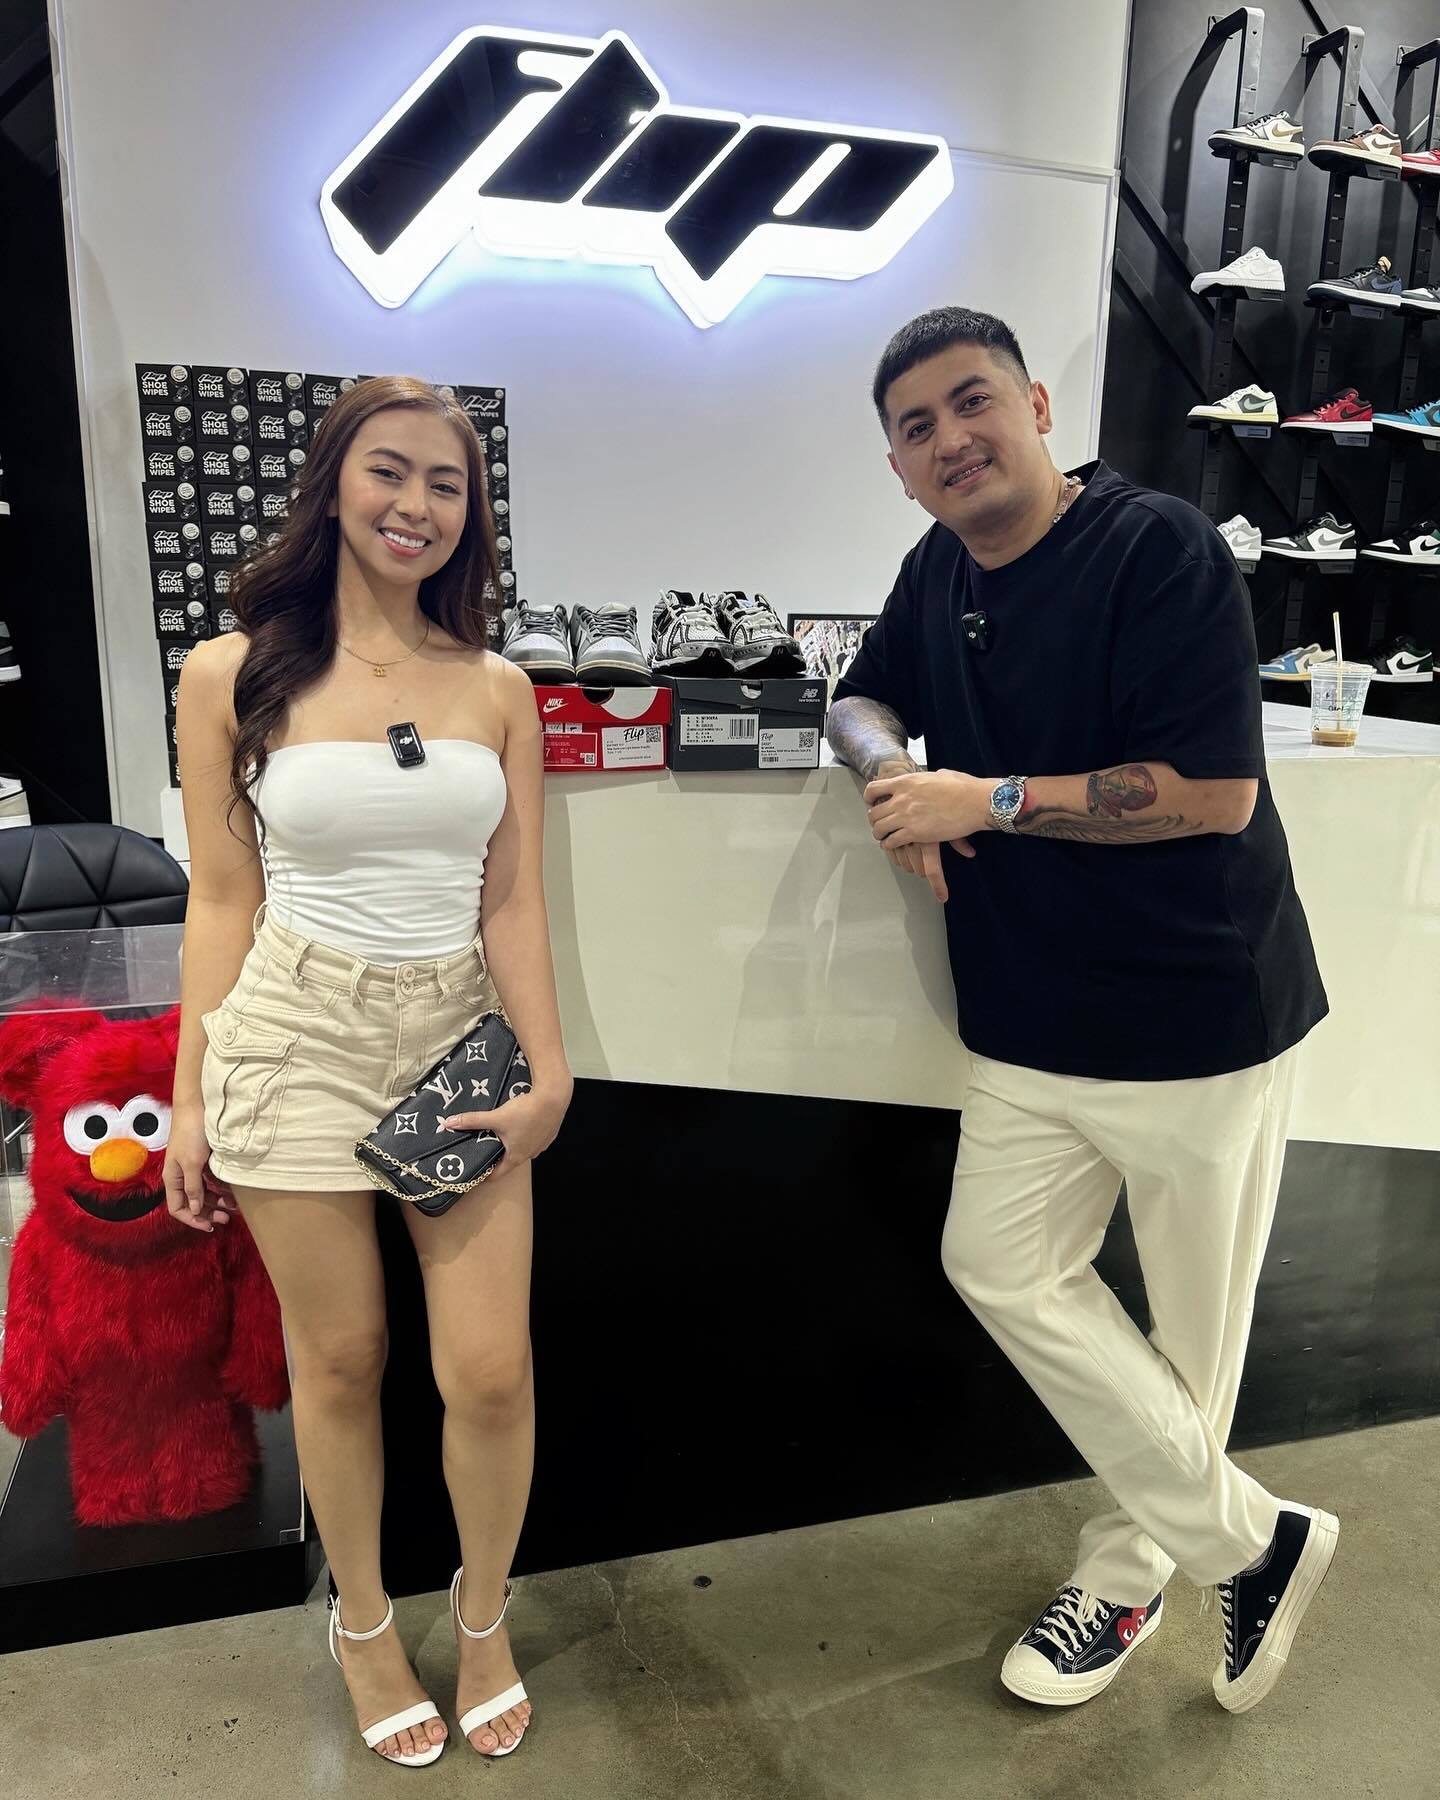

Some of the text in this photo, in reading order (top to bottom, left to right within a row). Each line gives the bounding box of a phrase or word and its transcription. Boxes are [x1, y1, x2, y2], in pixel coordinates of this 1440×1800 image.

[198, 383, 224, 392] SHOE
[257, 395, 283, 403] WIPES
[313, 392, 337, 400] SHOE
[547, 698, 564, 706] NIKE
[624, 728, 644, 741] Flip
[546, 748, 550, 757] 7
